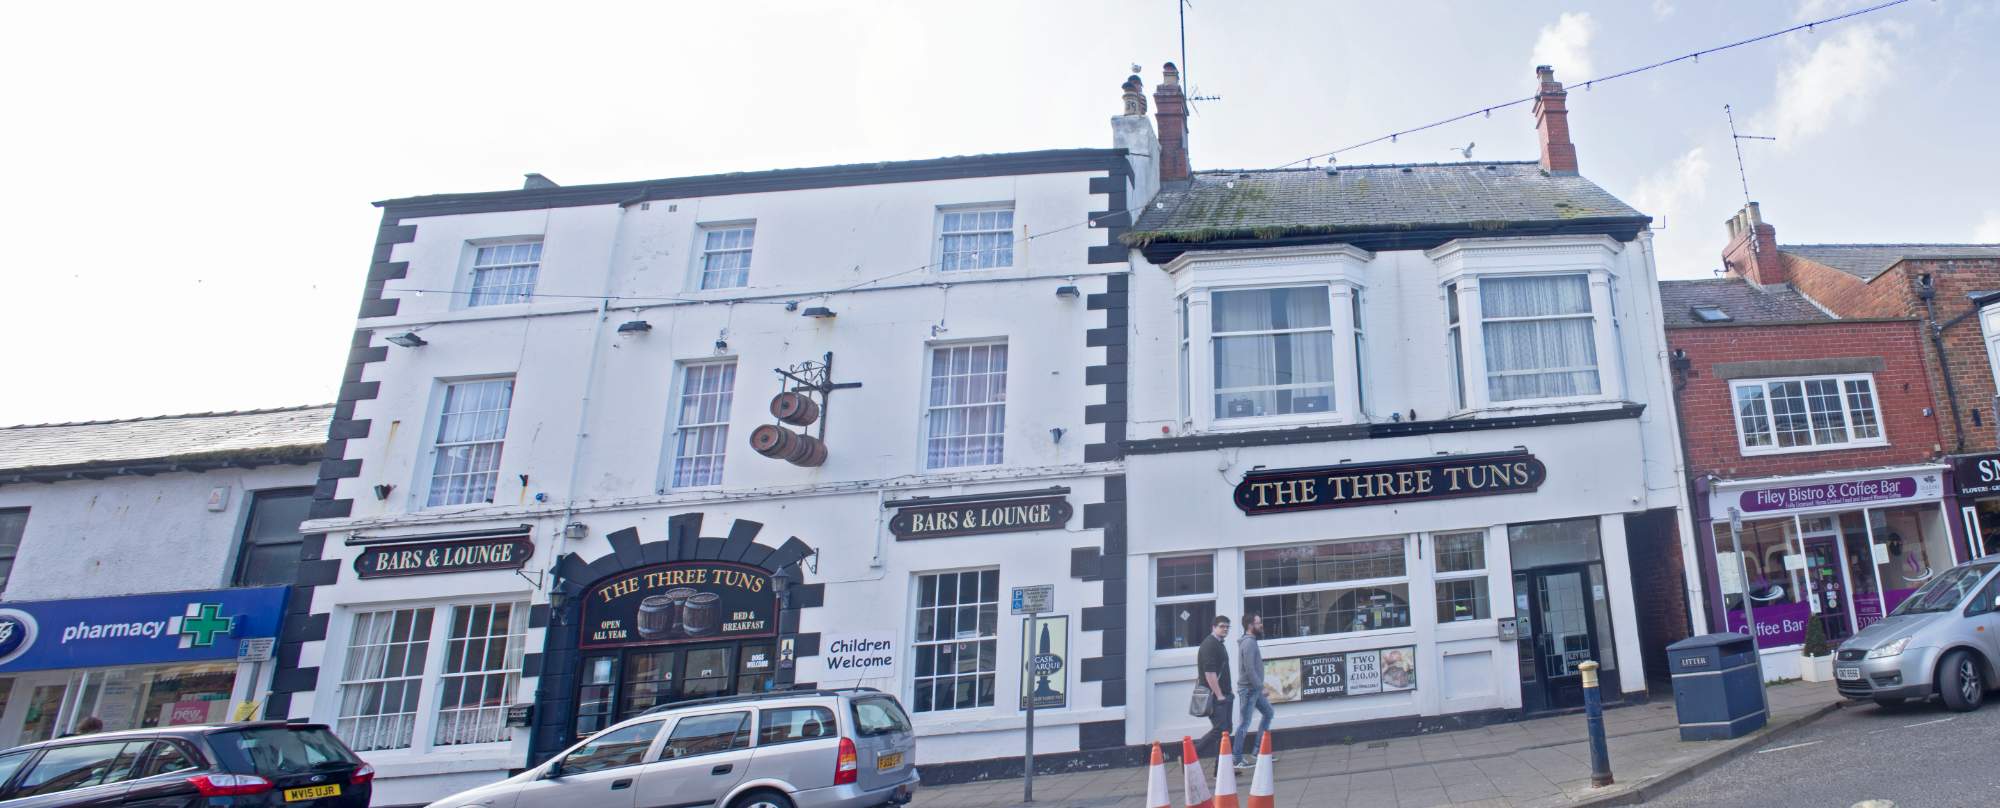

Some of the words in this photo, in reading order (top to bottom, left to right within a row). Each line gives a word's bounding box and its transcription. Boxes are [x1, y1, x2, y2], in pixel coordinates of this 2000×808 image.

[1251, 479, 1317, 506] THE
[1328, 470, 1433, 500] THREE
[1444, 462, 1529, 491] TUNS
[1757, 489, 1785, 506] Filey
[1789, 488, 1824, 502] Bistro
[1827, 484, 1837, 498] &
[1840, 481, 1878, 497] Coffee
[1881, 480, 1900, 493] Bar
[911, 511, 958, 532] BARS
[963, 509, 976, 529] &
[981, 504, 1050, 527] LOUNGE
[376, 549, 423, 571] BARS
[426, 549, 439, 568] &
[443, 543, 513, 566] LOUNGE
[598, 577, 640, 603] THE
[644, 569, 707, 589] THREE
[712, 569, 765, 593] TUNS
[733, 611, 748, 621] BED
[749, 610, 755, 619] &
[601, 620, 621, 630] OPEN
[723, 620, 764, 632] BREAKFAST
[1738, 622, 1781, 636] Cffee
[1783, 619, 1804, 632] Bar
[61, 621, 165, 644] pharmacy
[592, 631, 606, 640] ALL
[607, 629, 627, 639] YEAR
[830, 638, 891, 653] Children
[827, 655, 892, 670] Welcome
[1034, 655, 1053, 663] CASK
[1303, 656, 1343, 666] TRADITIONAL
[1353, 655, 1375, 664] TWO
[1682, 657, 1706, 666] LITTER
[1036, 662, 1061, 670] ARQUE
[1312, 664, 1336, 675] PUB
[1353, 663, 1374, 672] FOR
[1308, 674, 1340, 686] FOOD
[1351, 671, 1379, 681] £10.00
[1304, 687, 1326, 695] SERVED
[1327, 685, 1344, 693] DAILY
